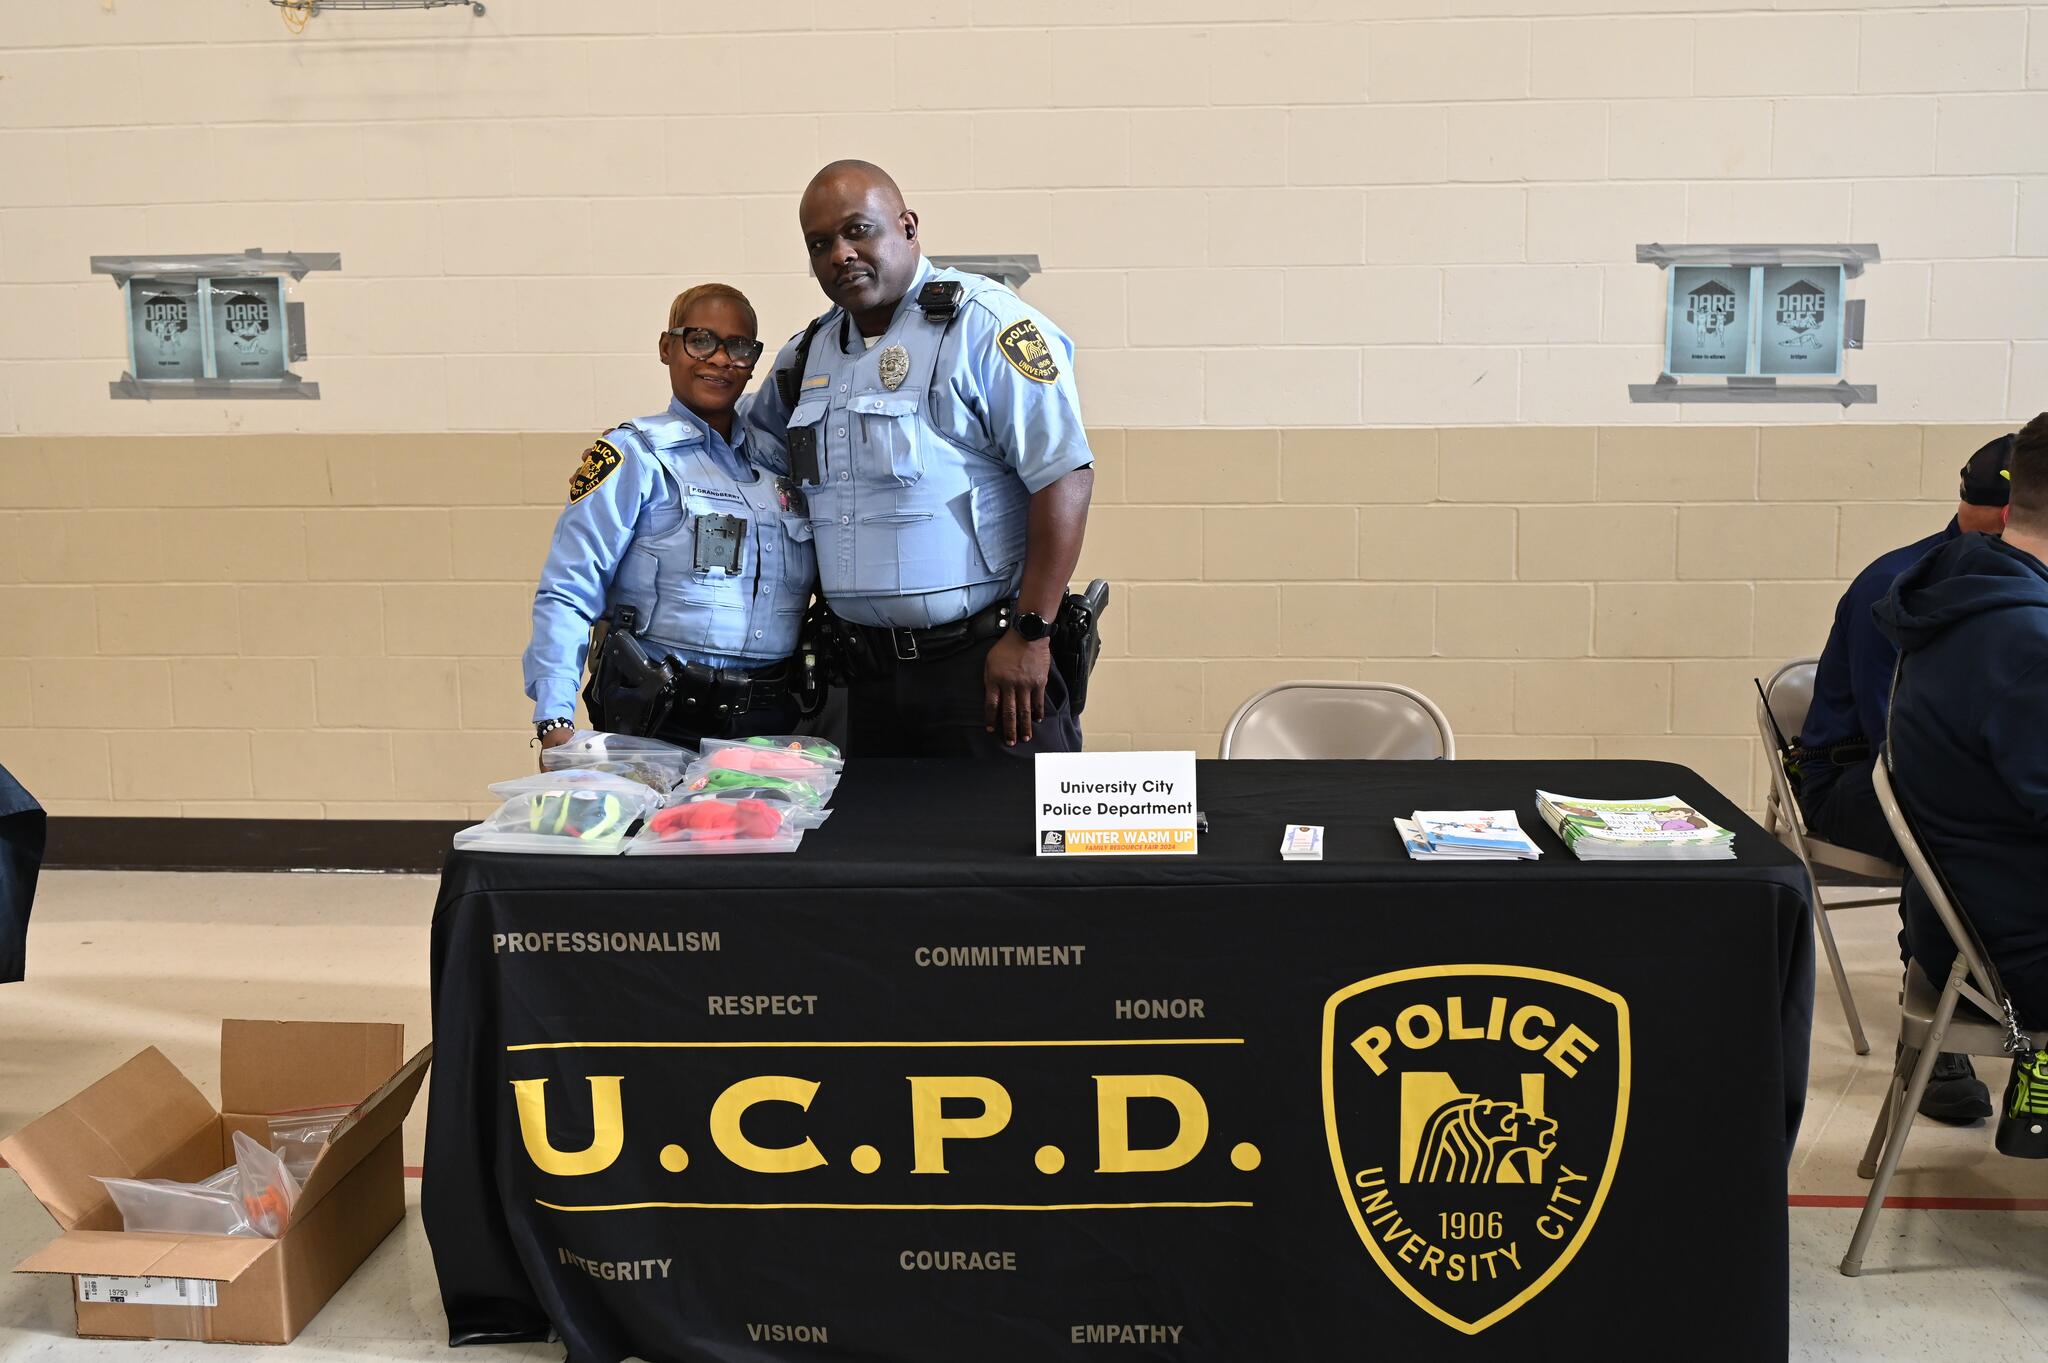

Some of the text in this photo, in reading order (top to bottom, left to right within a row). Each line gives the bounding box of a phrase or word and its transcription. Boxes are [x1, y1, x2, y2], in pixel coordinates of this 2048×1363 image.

[145, 303, 187, 321] DARE
[225, 303, 269, 321] DARE
[1689, 294, 1735, 312] DARE
[1777, 294, 1825, 312] DARE
[1005, 323, 1037, 347] POLIC
[1060, 780, 1174, 796] University City
[1043, 801, 1192, 818] Police Department
[1067, 831, 1193, 844] WINTER WARM UP
[493, 931, 721, 954] PROFESSIONALISM
[914, 946, 1086, 967] COMMITMENT
[707, 995, 818, 1016] RESPECT
[1115, 998, 1205, 1020] HONOR
[1350, 996, 1600, 1079] POLICE
[509, 1074, 1262, 1177] U.C.P.D.
[1356, 1164, 1589, 1282] UNIVERSITY CITY
[1439, 1211, 1503, 1240] 1906
[558, 1247, 673, 1281] INTEGRITY
[899, 1250, 1017, 1271] COURAGE
[746, 1323, 828, 1343] VISION
[1071, 1324, 1183, 1344] EMPATHY
